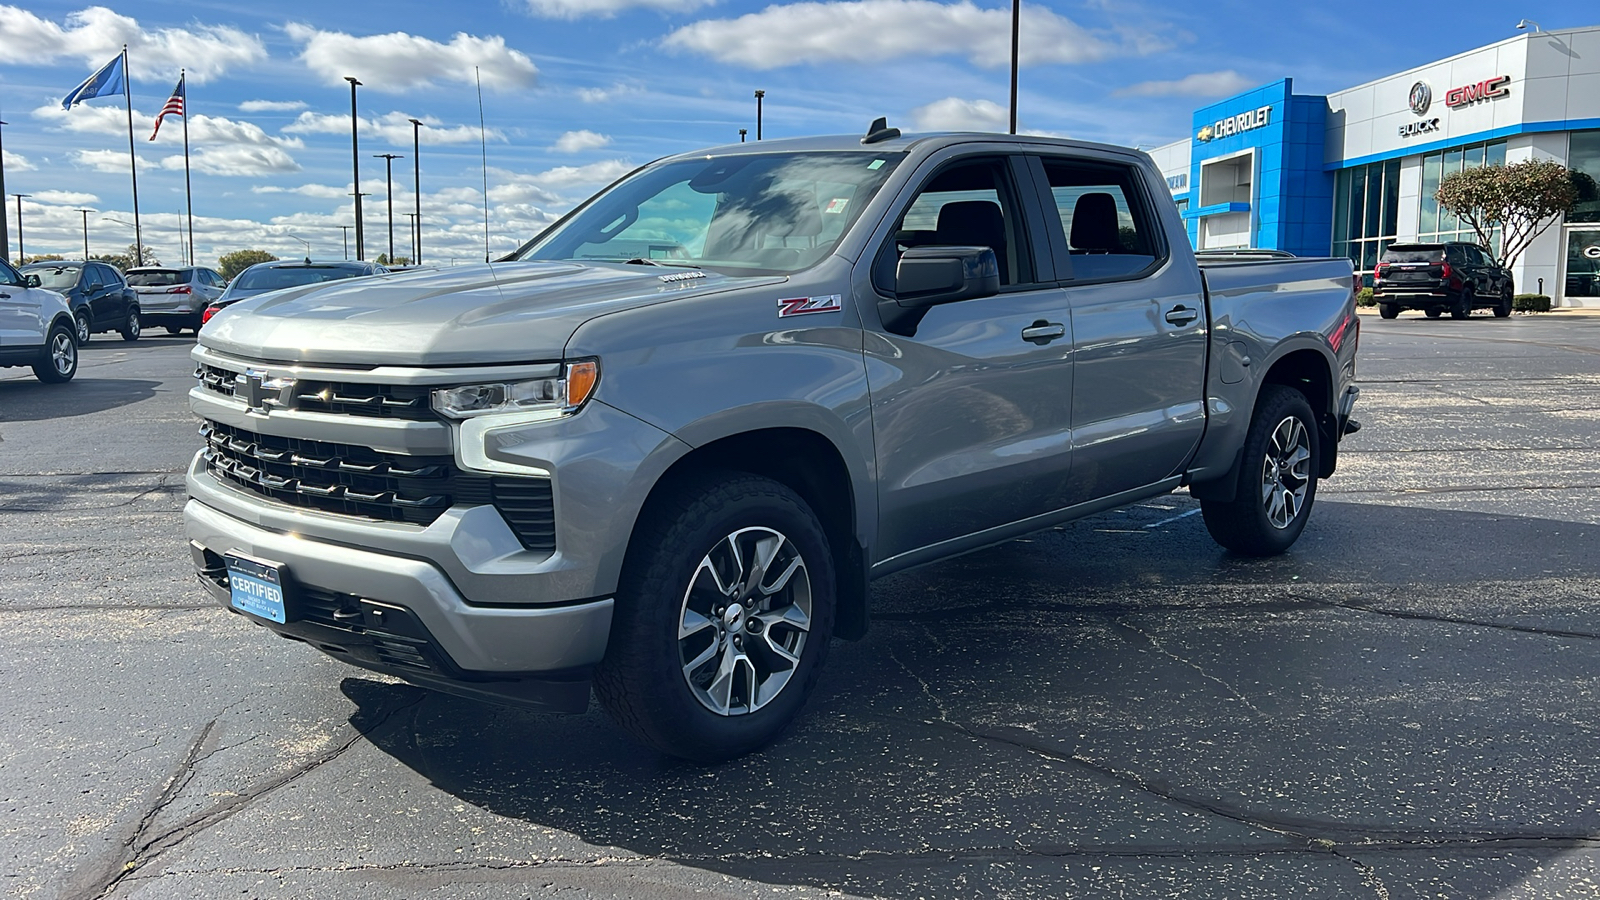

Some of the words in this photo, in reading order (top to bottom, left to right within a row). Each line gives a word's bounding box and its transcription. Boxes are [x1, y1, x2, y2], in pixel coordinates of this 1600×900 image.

[1445, 75, 1510, 109] GMC
[1214, 105, 1272, 139] CHEVROLET
[1398, 118, 1440, 138] BUICK
[777, 293, 842, 319] Z71
[231, 575, 281, 603] CERTIFIED
